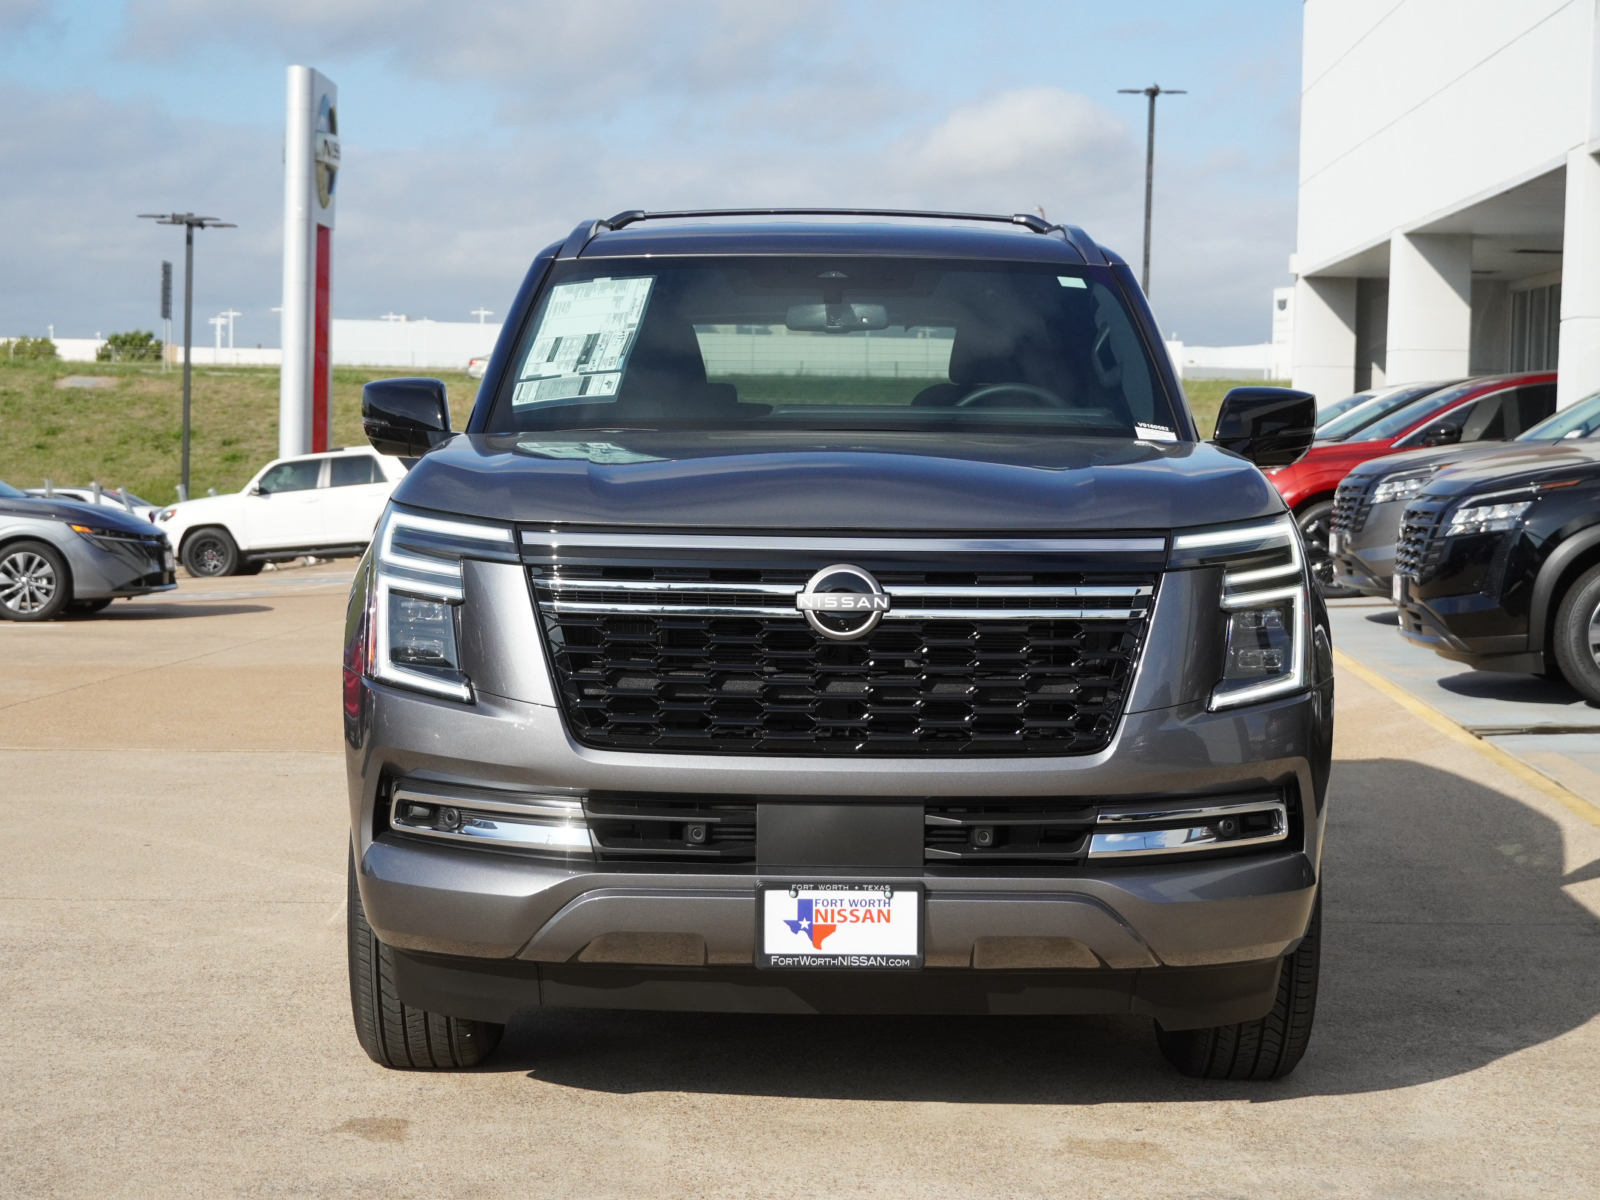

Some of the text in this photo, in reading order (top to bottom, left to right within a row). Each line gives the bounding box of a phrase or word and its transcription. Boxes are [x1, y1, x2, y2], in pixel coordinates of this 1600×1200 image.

[799, 597, 888, 608] NISSAN
[815, 898, 891, 908] FORT WORTH
[815, 909, 891, 923] NISSAN
